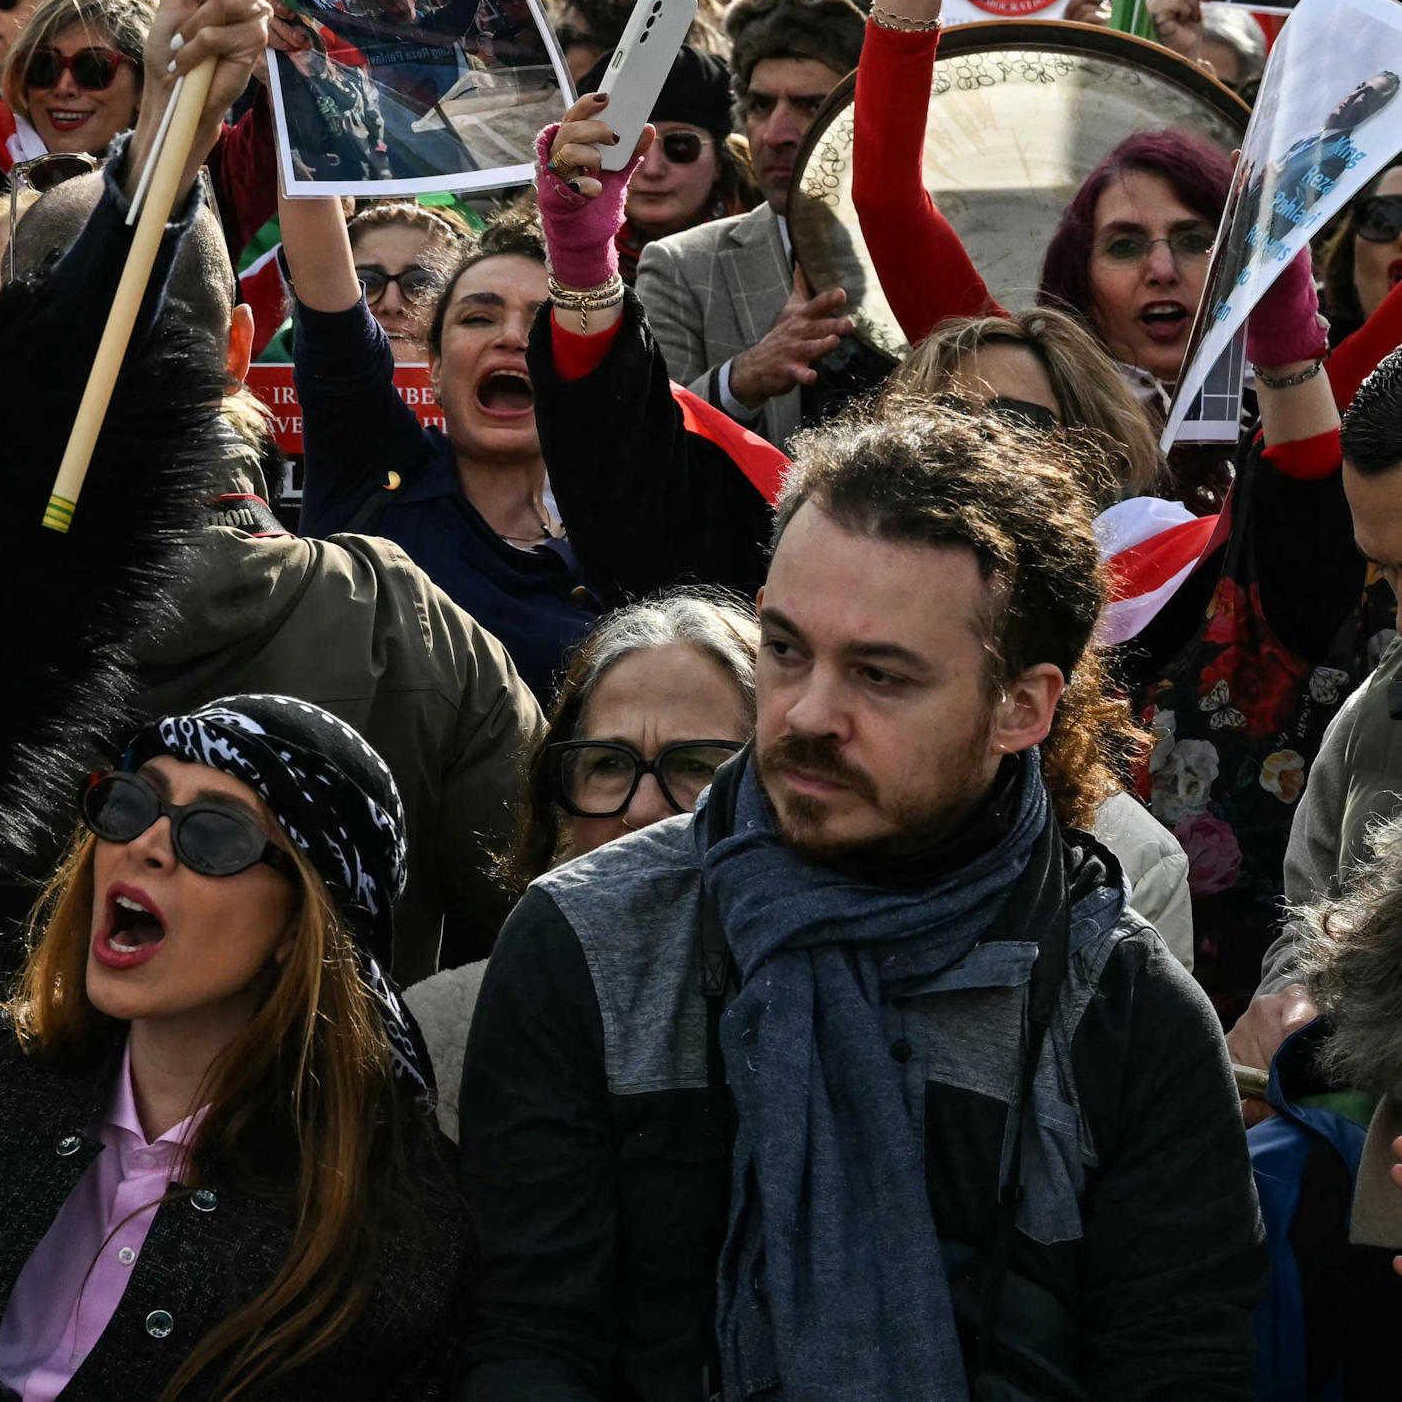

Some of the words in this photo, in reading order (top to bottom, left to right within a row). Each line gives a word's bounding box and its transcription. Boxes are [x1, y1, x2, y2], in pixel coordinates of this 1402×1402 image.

[1330, 135, 1367, 170] King
[1300, 164, 1340, 196] Reza
[211, 508, 254, 527] non
